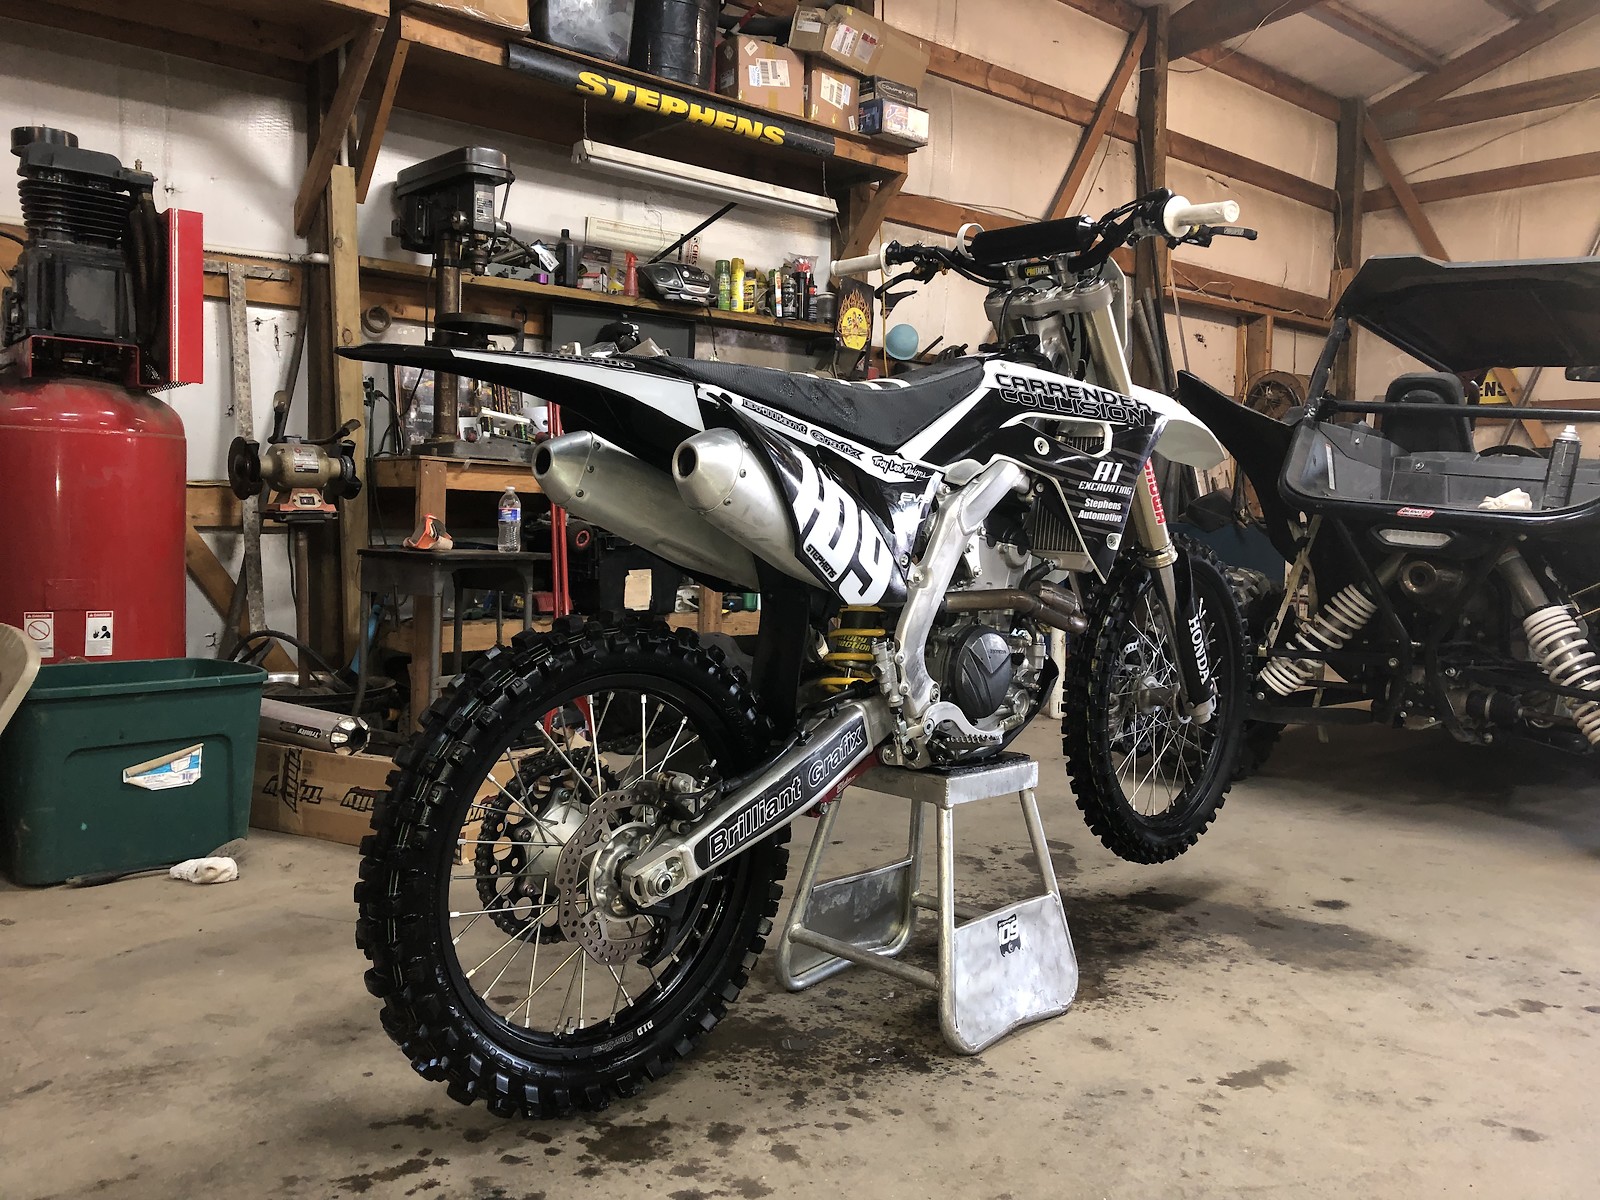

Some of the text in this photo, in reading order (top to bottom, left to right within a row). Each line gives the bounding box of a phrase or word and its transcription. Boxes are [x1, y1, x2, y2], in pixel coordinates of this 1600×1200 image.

[576, 71, 785, 146] STEPHENS
[995, 373, 1153, 415] CARRENDER
[998, 388, 1149, 427] COLLISION
[742, 399, 865, 461] Brilliant Grafix
[872, 455, 932, 481] Troy Lee Designs
[1092, 460, 1124, 483] A1
[1078, 480, 1133, 496] EXCAVATING
[1084, 498, 1122, 511] Stephens
[1078, 510, 1123, 523] Automotive
[805, 543, 838, 579] STEPHENS
[1188, 613, 1210, 686] HONDA
[297, 727, 322, 740] Trinity
[708, 725, 864, 862] Brilliant Grafix
